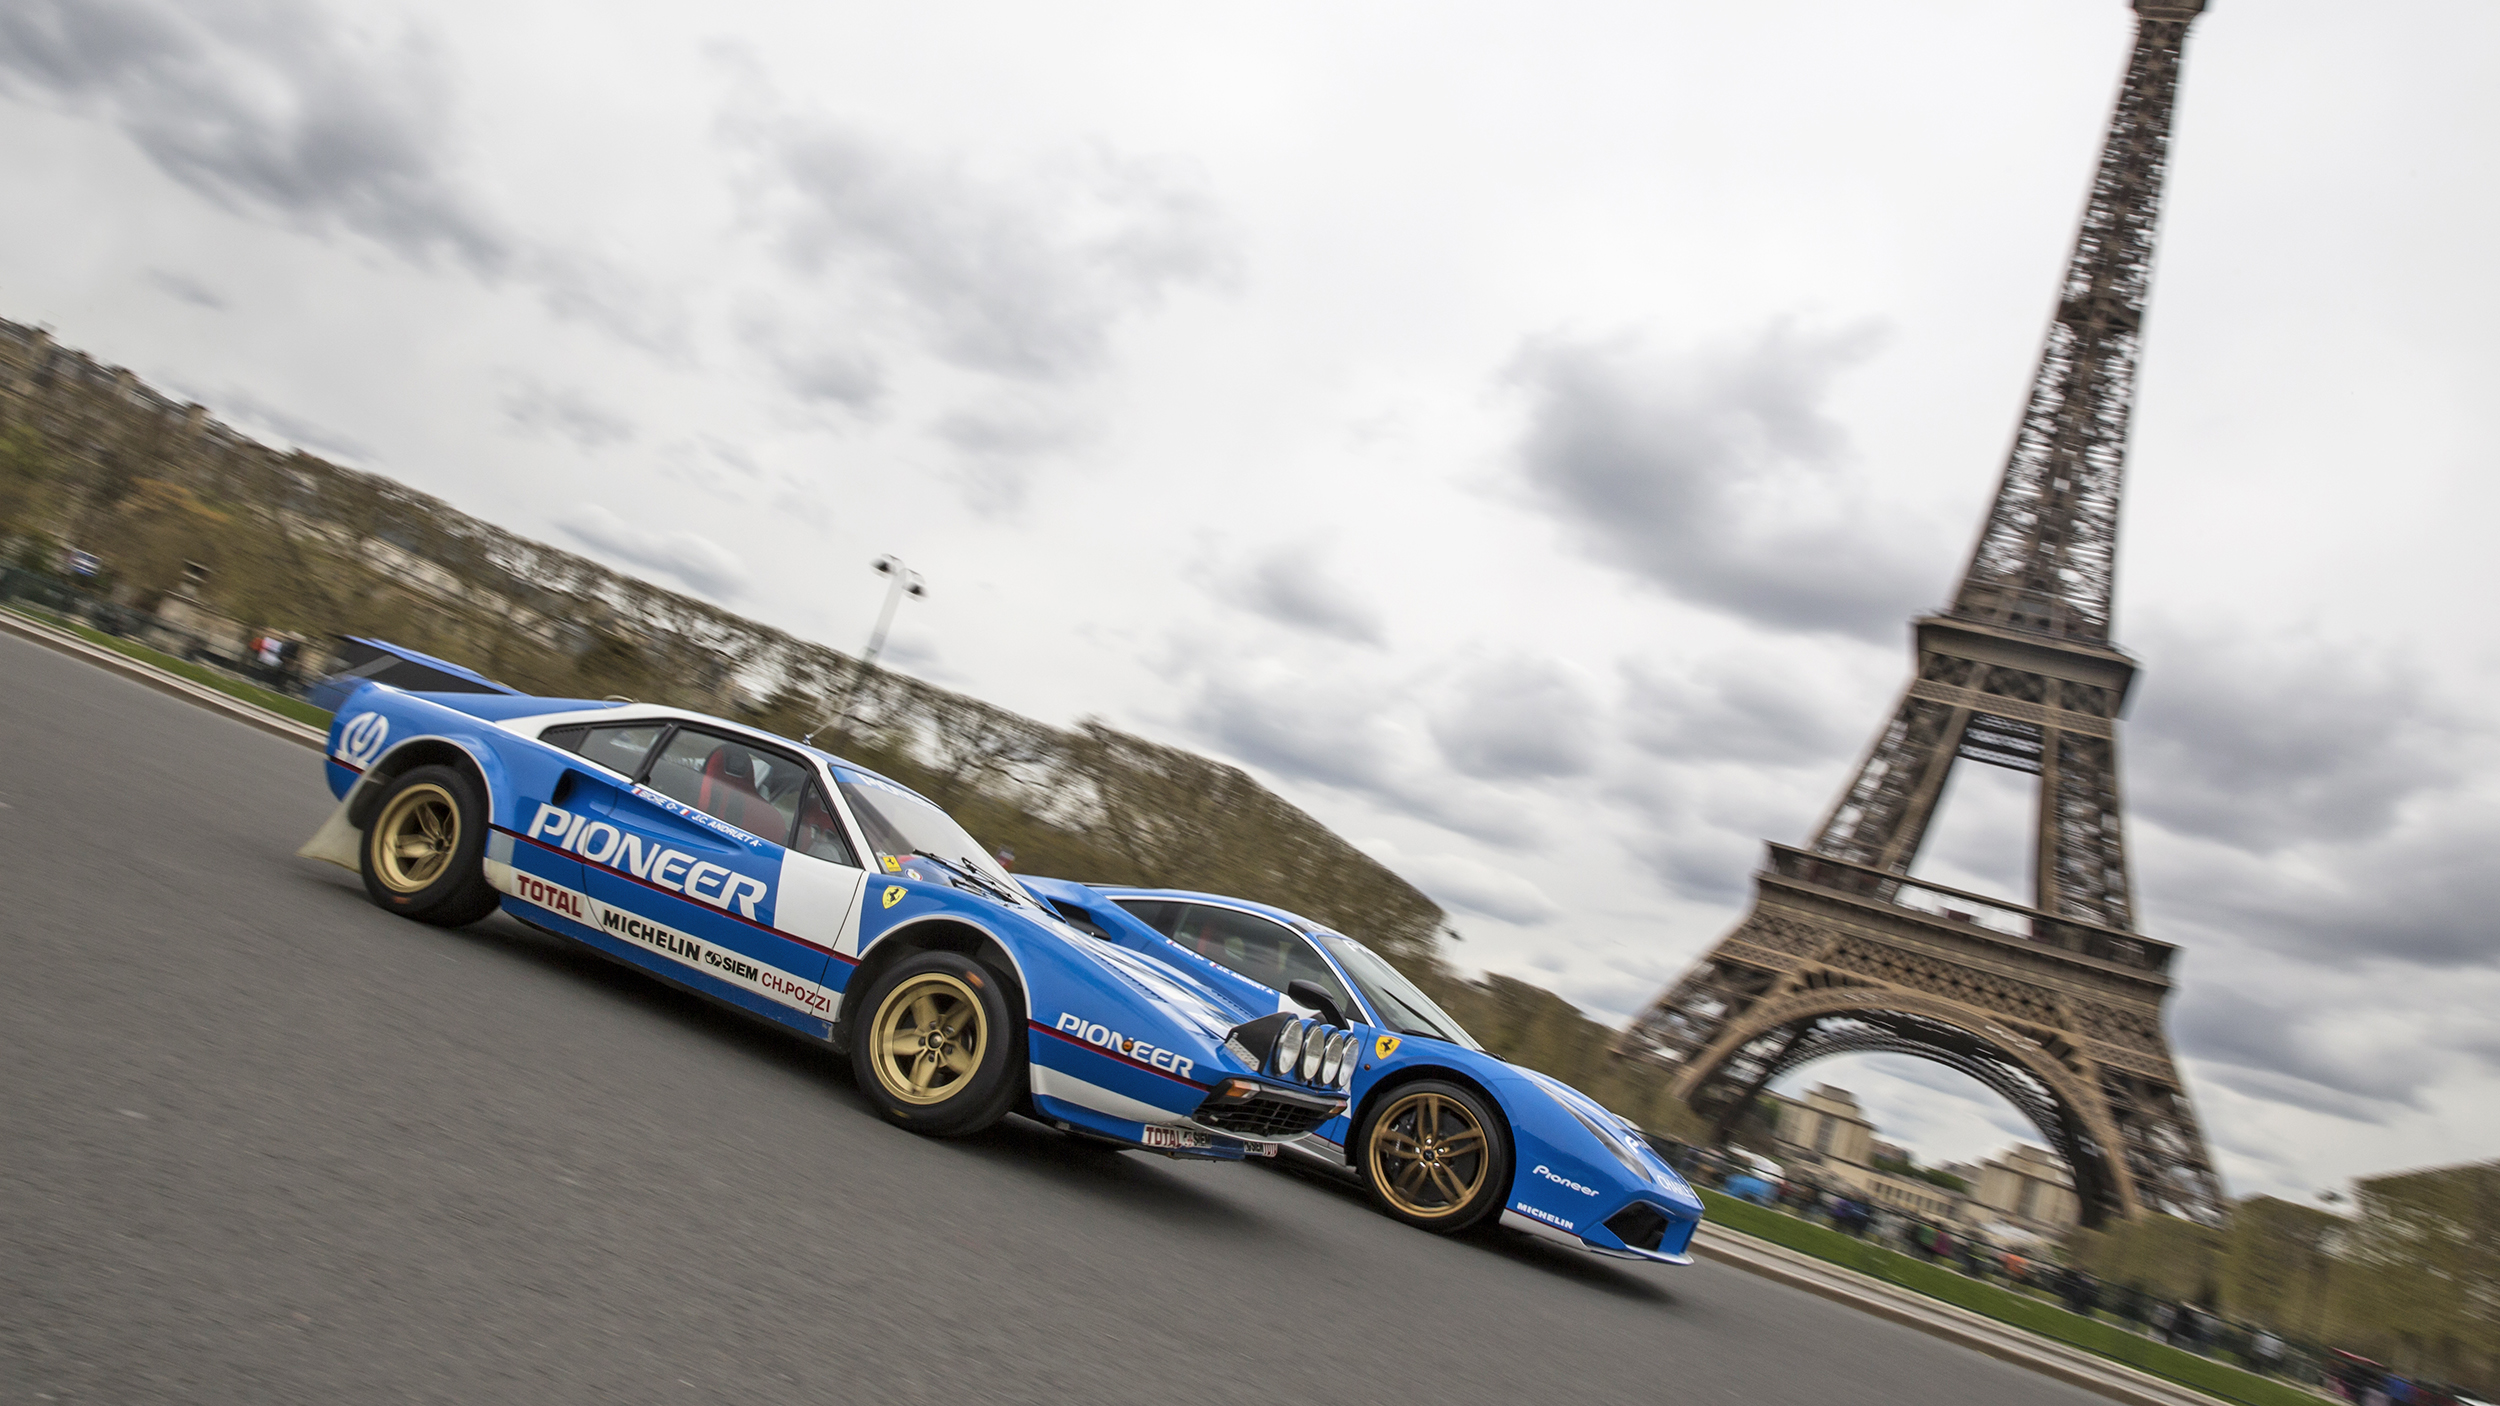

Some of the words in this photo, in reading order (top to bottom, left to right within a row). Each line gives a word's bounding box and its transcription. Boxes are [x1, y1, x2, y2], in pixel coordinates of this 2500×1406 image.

[707, 820, 752, 843] ANDRUET
[527, 803, 767, 922] PIONEER
[517, 874, 582, 918] TOTAL
[603, 909, 701, 962] MICHELIN
[722, 957, 758, 982] SIEM
[761, 972, 831, 1013] CH.POZZI
[1055, 1012, 1194, 1079] PIONEER
[1145, 1126, 1181, 1149] TOTAL
[1532, 1165, 1600, 1197] Pioneer
[1516, 1201, 1574, 1230] MICHELIN
